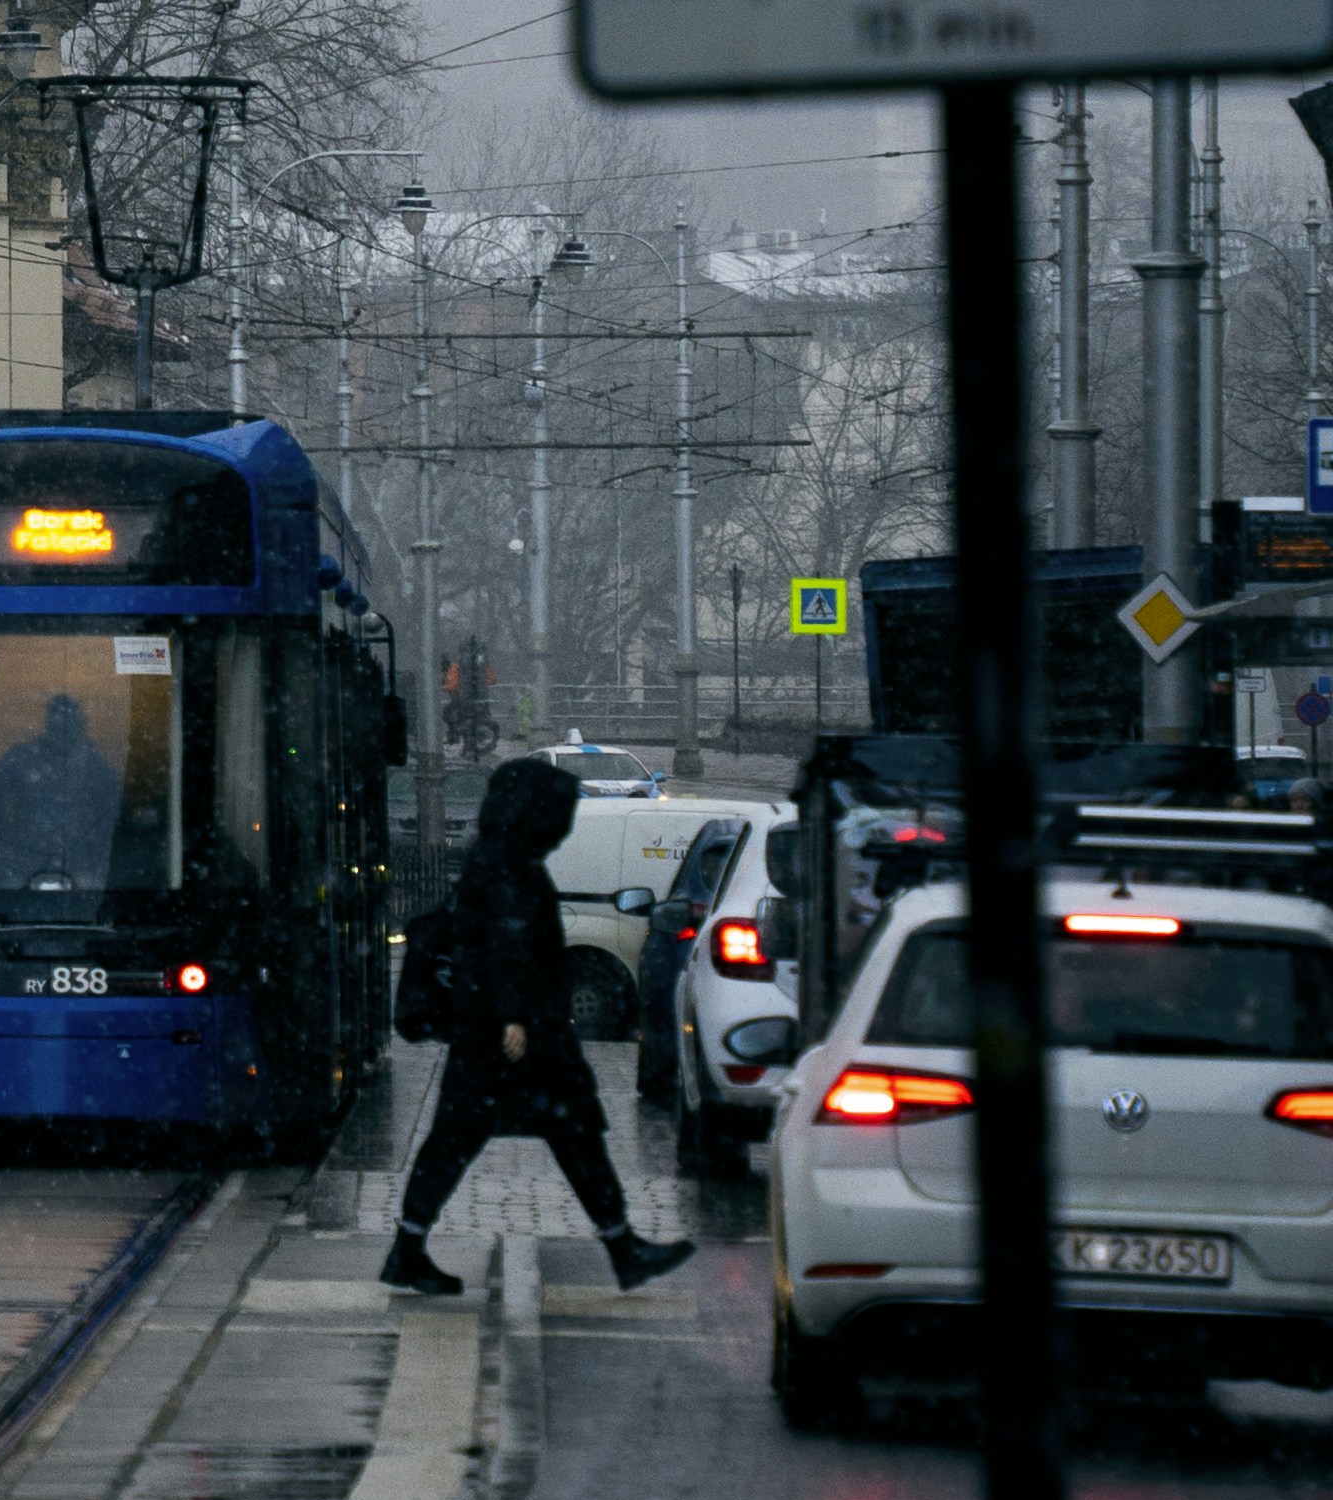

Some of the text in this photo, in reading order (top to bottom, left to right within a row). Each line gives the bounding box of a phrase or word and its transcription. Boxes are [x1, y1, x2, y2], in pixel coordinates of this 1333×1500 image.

[24, 508, 103, 531] Borek
[26, 966, 108, 994] RY 838
[1107, 1237, 1220, 1273] 23650
